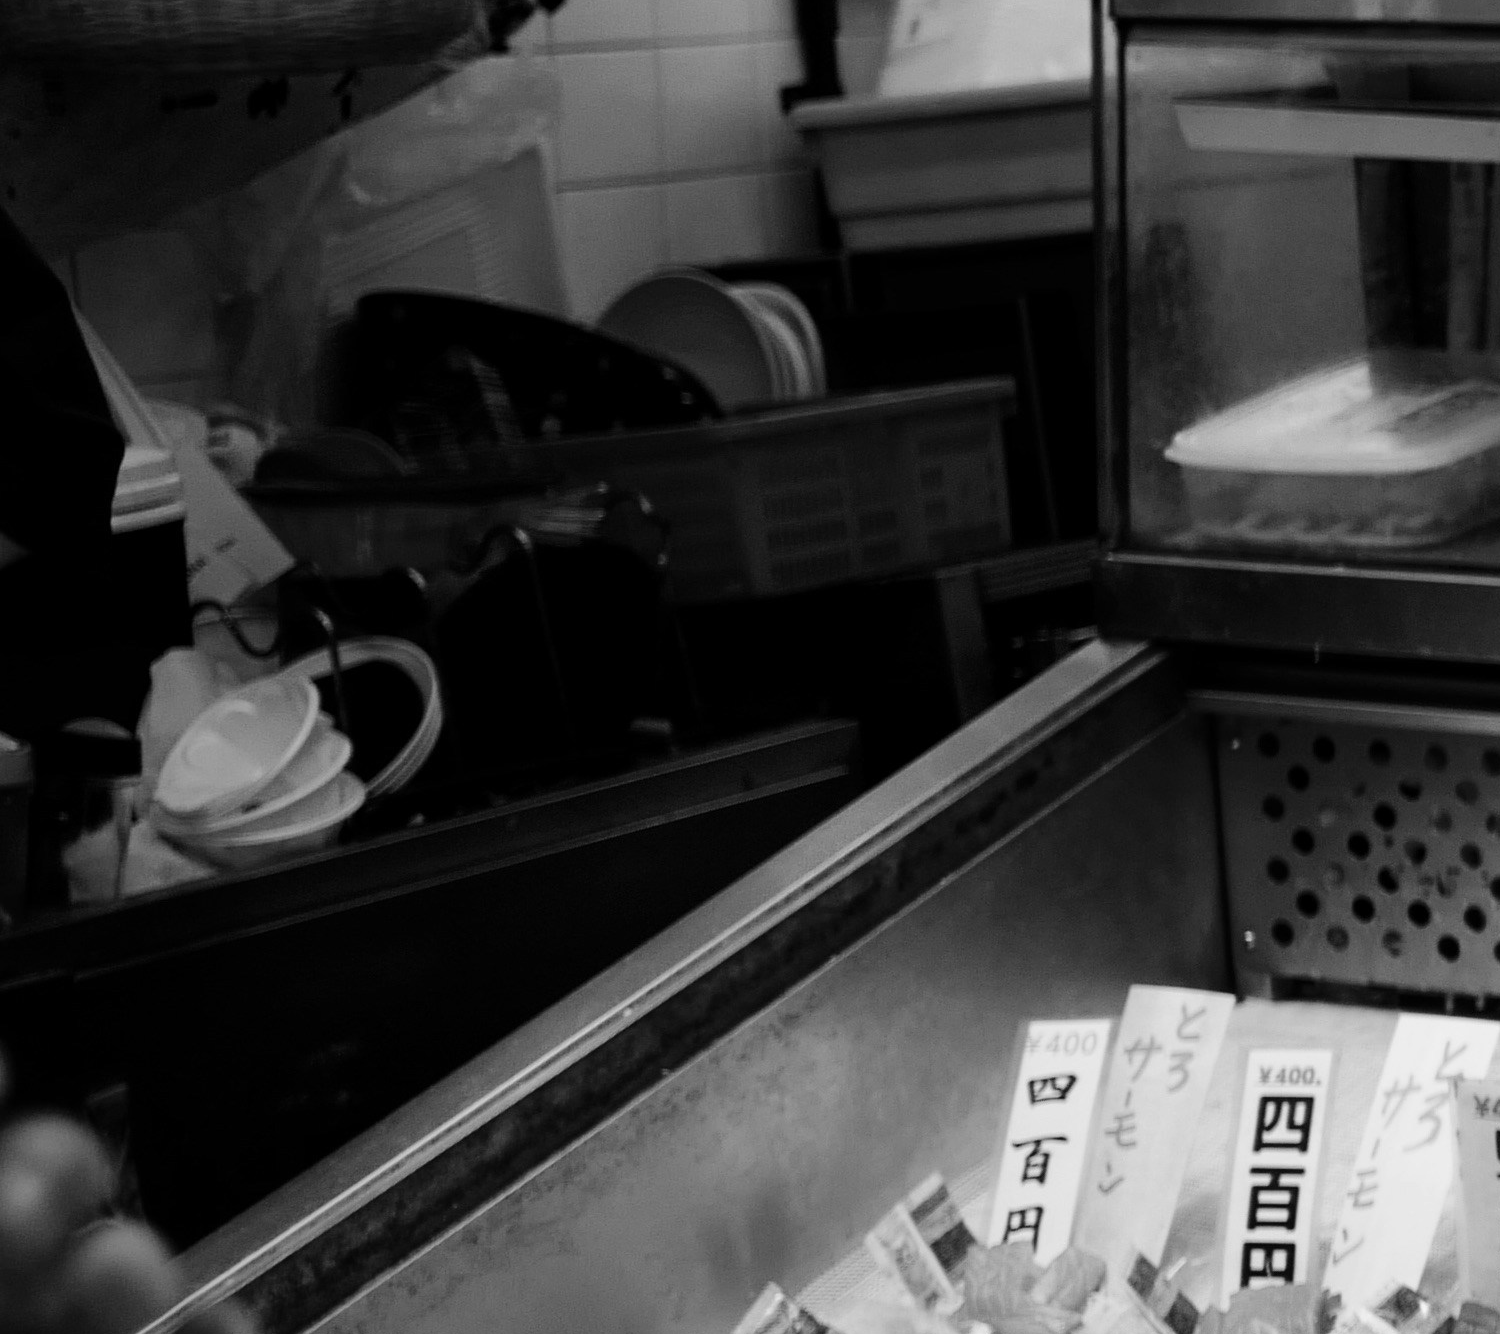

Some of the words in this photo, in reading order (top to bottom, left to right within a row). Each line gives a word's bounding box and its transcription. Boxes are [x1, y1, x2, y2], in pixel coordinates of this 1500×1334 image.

[1000, 1073, 1077, 1255] 四百円
[1099, 1035, 1163, 1195] サーモン
[1240, 1095, 1316, 1288] 四百円
[1332, 1073, 1424, 1264] サーモン
